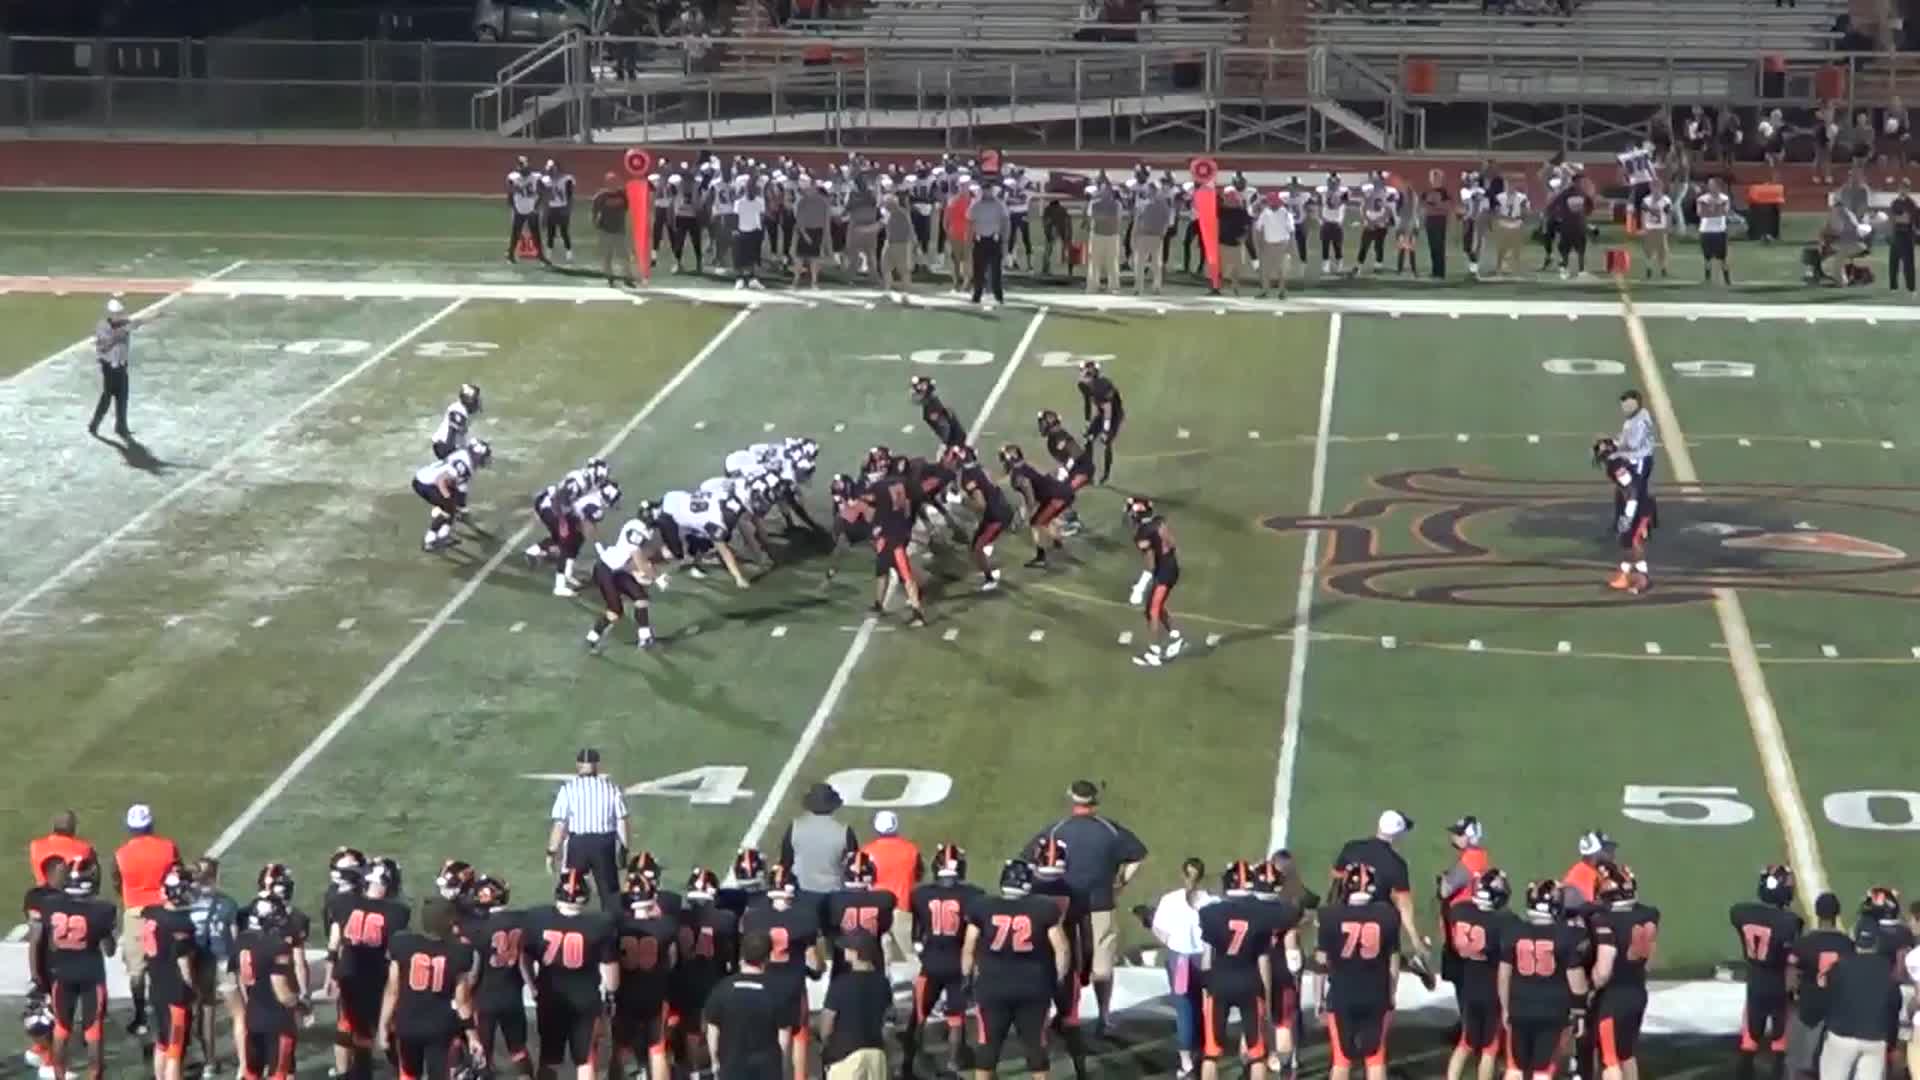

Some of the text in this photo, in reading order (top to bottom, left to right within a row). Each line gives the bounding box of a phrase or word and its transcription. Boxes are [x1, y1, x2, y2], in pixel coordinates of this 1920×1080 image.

[50, 911, 88, 950] 22
[343, 908, 385, 947] 46
[928, 899, 960, 936] 16
[991, 915, 1033, 952] 72
[1227, 919, 1249, 955] 7
[542, 928, 585, 969] 70
[1340, 920, 1382, 959] 79
[408, 951, 447, 992] 61
